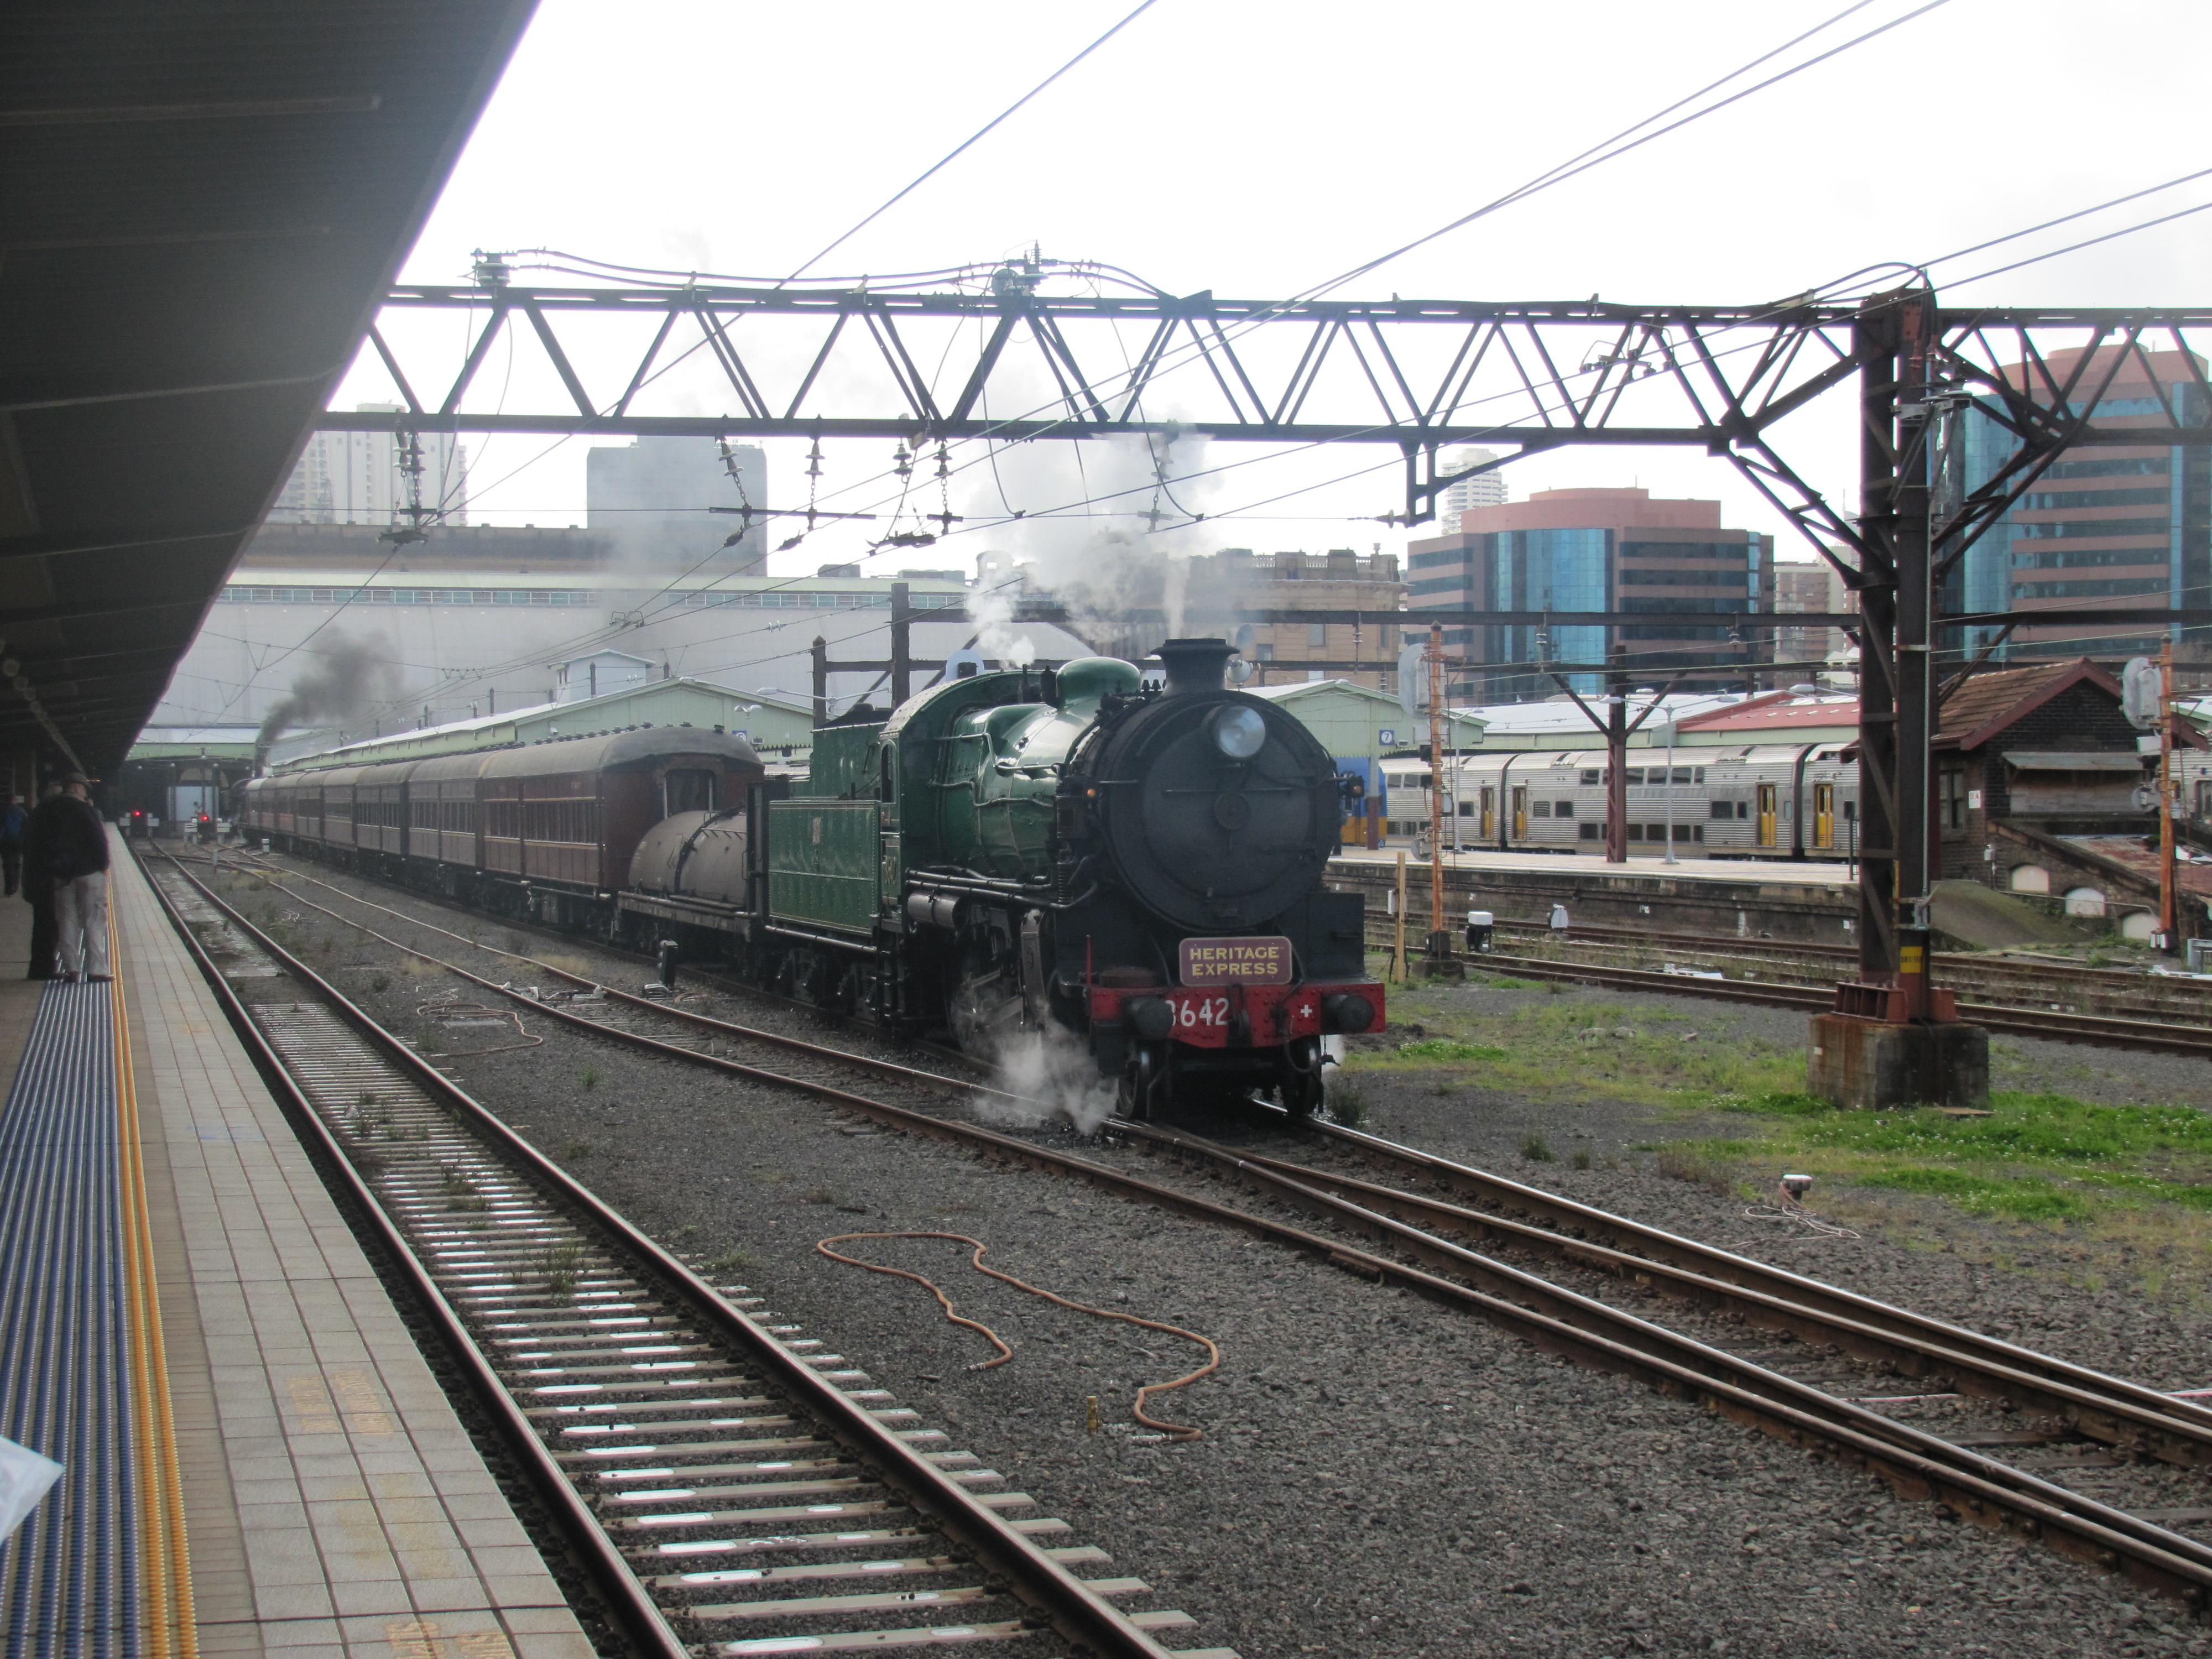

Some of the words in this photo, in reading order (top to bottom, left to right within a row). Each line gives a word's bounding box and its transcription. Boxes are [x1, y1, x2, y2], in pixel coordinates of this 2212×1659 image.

[1384, 733, 1390, 741] 7
[1190, 947, 1279, 960] HERITAGE
[1192, 962, 1279, 976] EXPRESS
